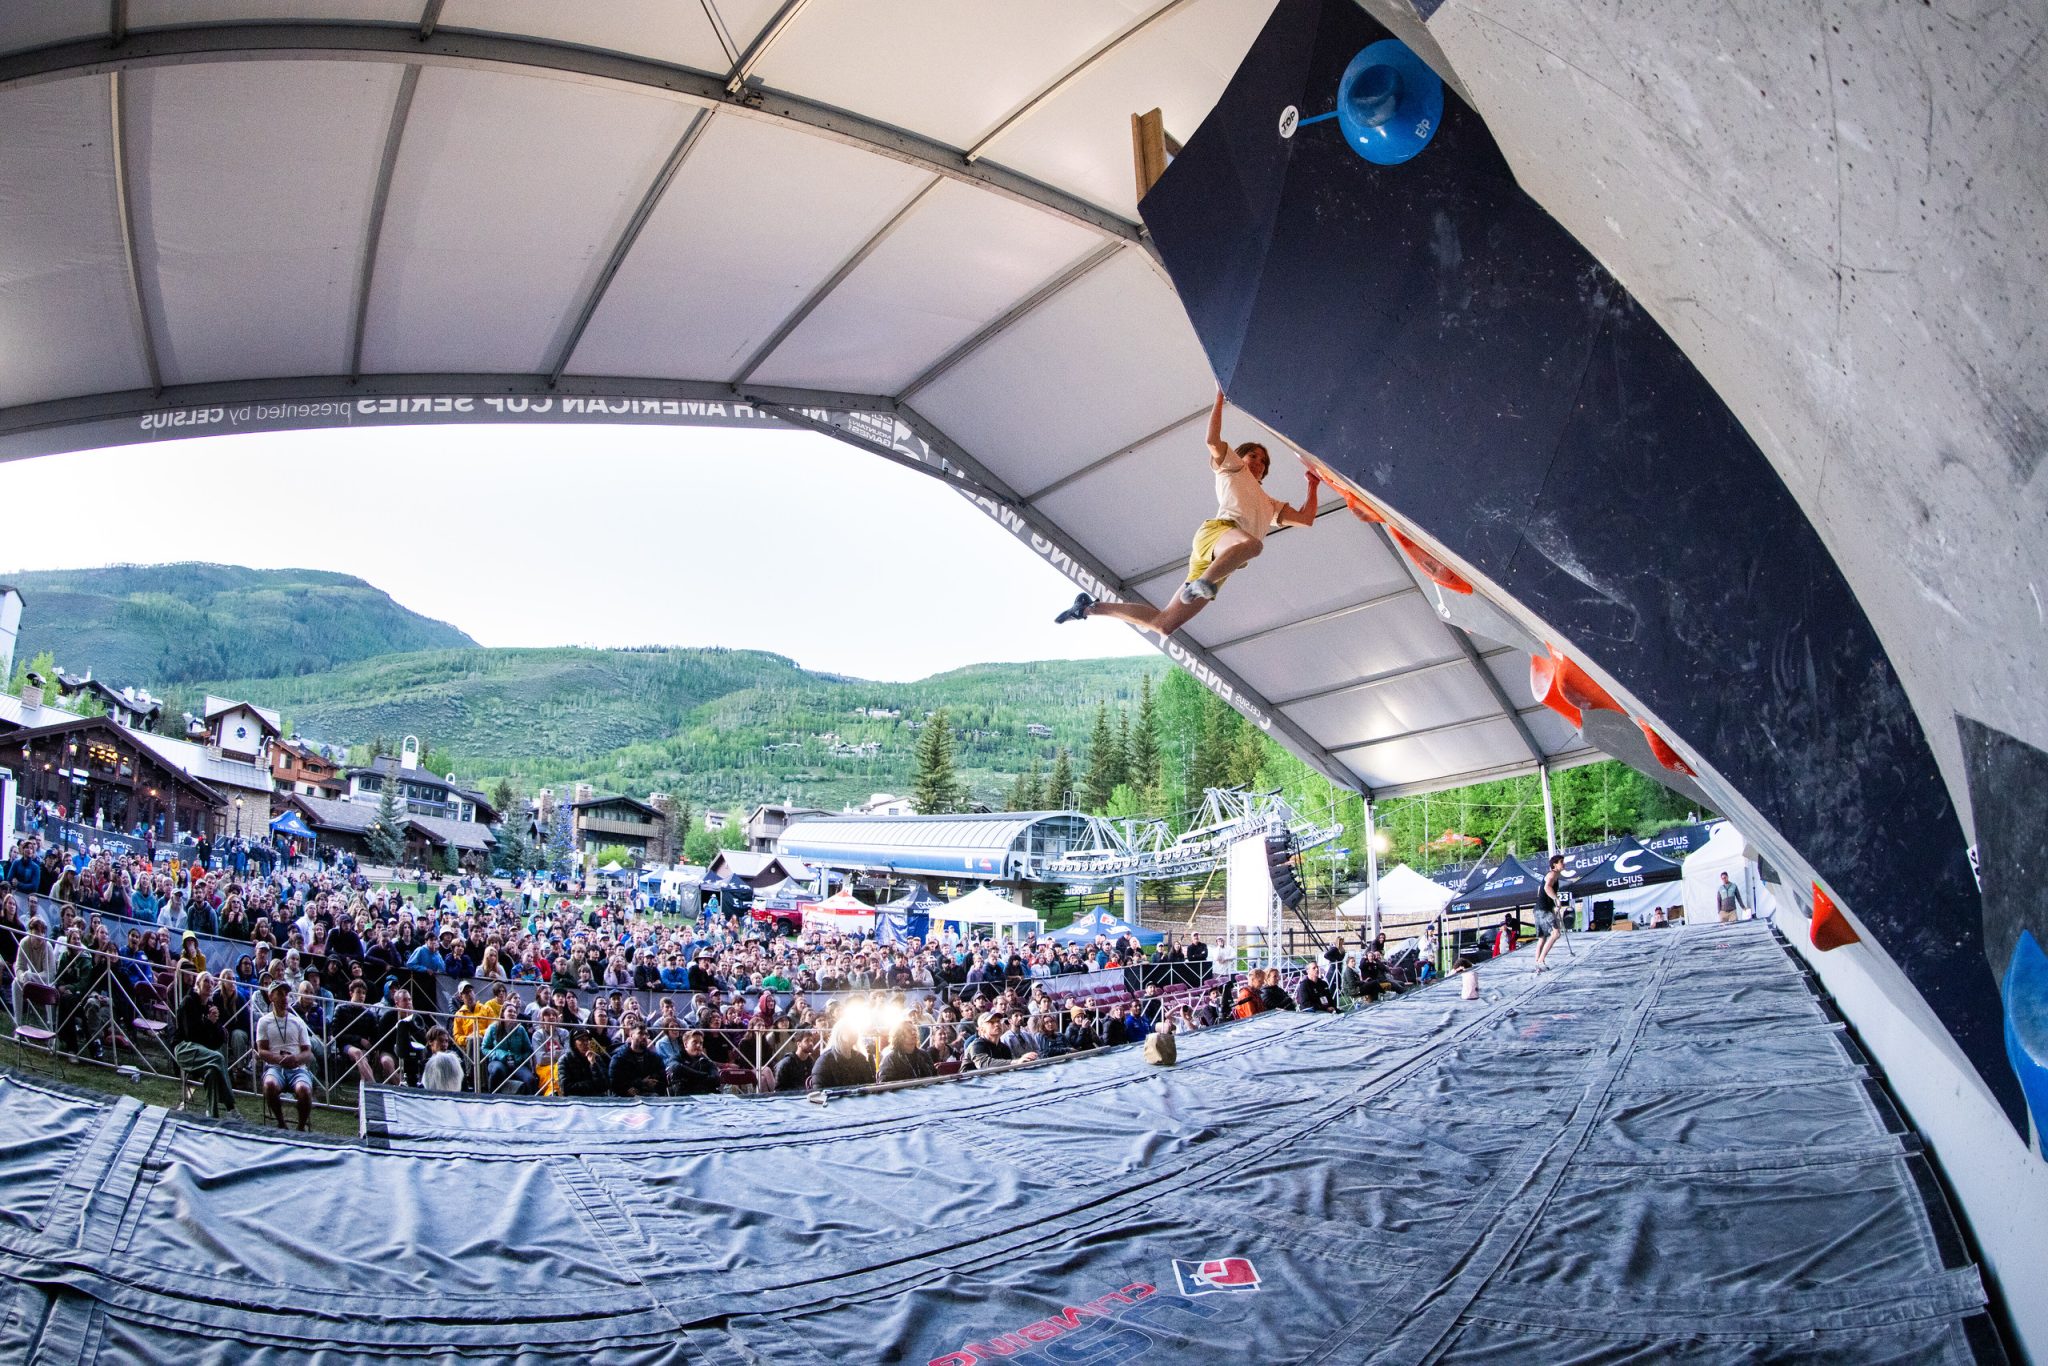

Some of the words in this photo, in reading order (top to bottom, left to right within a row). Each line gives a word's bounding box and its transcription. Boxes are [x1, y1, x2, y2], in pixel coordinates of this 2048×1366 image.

[1281, 111, 1296, 131] TOP
[1650, 836, 1688, 850] CELSIUS
[1606, 875, 1644, 887] CELSIUS
